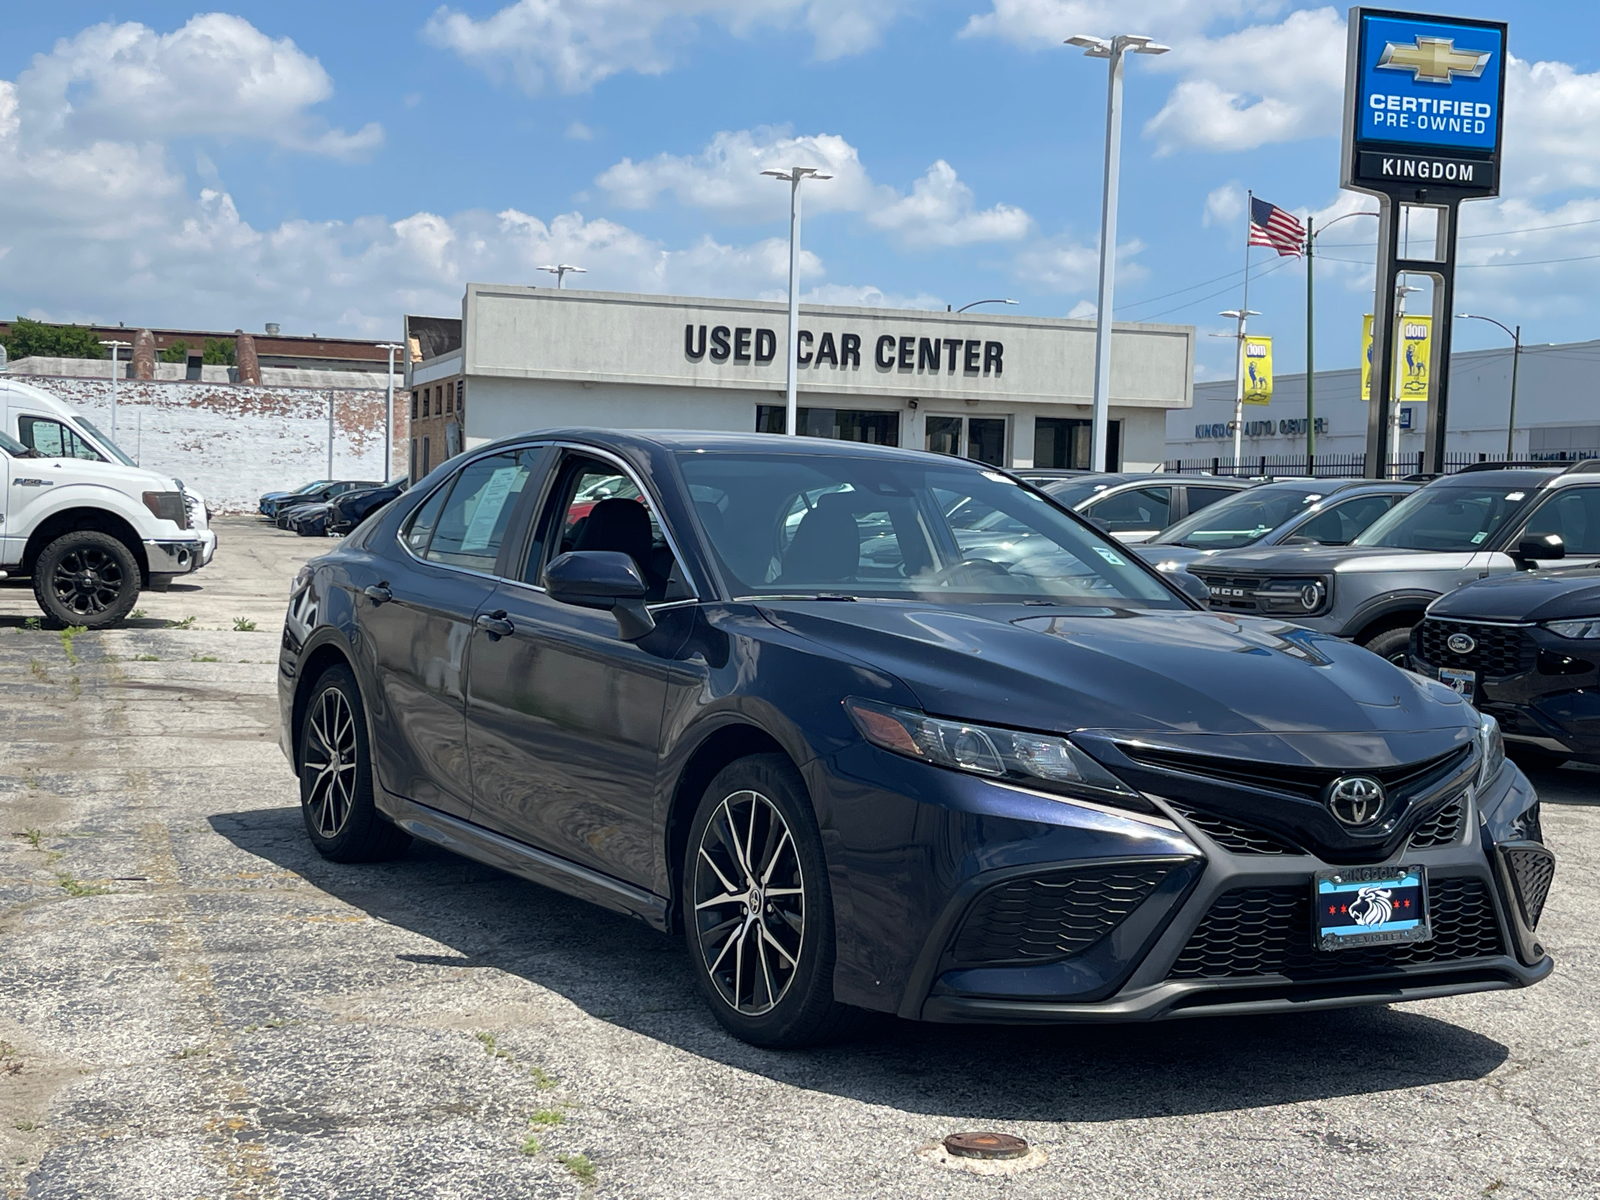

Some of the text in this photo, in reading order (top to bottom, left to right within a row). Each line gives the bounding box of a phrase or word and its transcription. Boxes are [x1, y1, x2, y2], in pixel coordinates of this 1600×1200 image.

[1369, 93, 1491, 118] CERTIFIED
[1373, 111, 1485, 134] PRE-OWNED
[1382, 158, 1473, 181] KINGDOM
[1404, 322, 1427, 338] dom
[685, 323, 1005, 374] USED CAR CENTER
[1246, 342, 1266, 356] dom
[1195, 422, 1238, 438] KINGDO
[1244, 420, 1274, 436] AUTO
